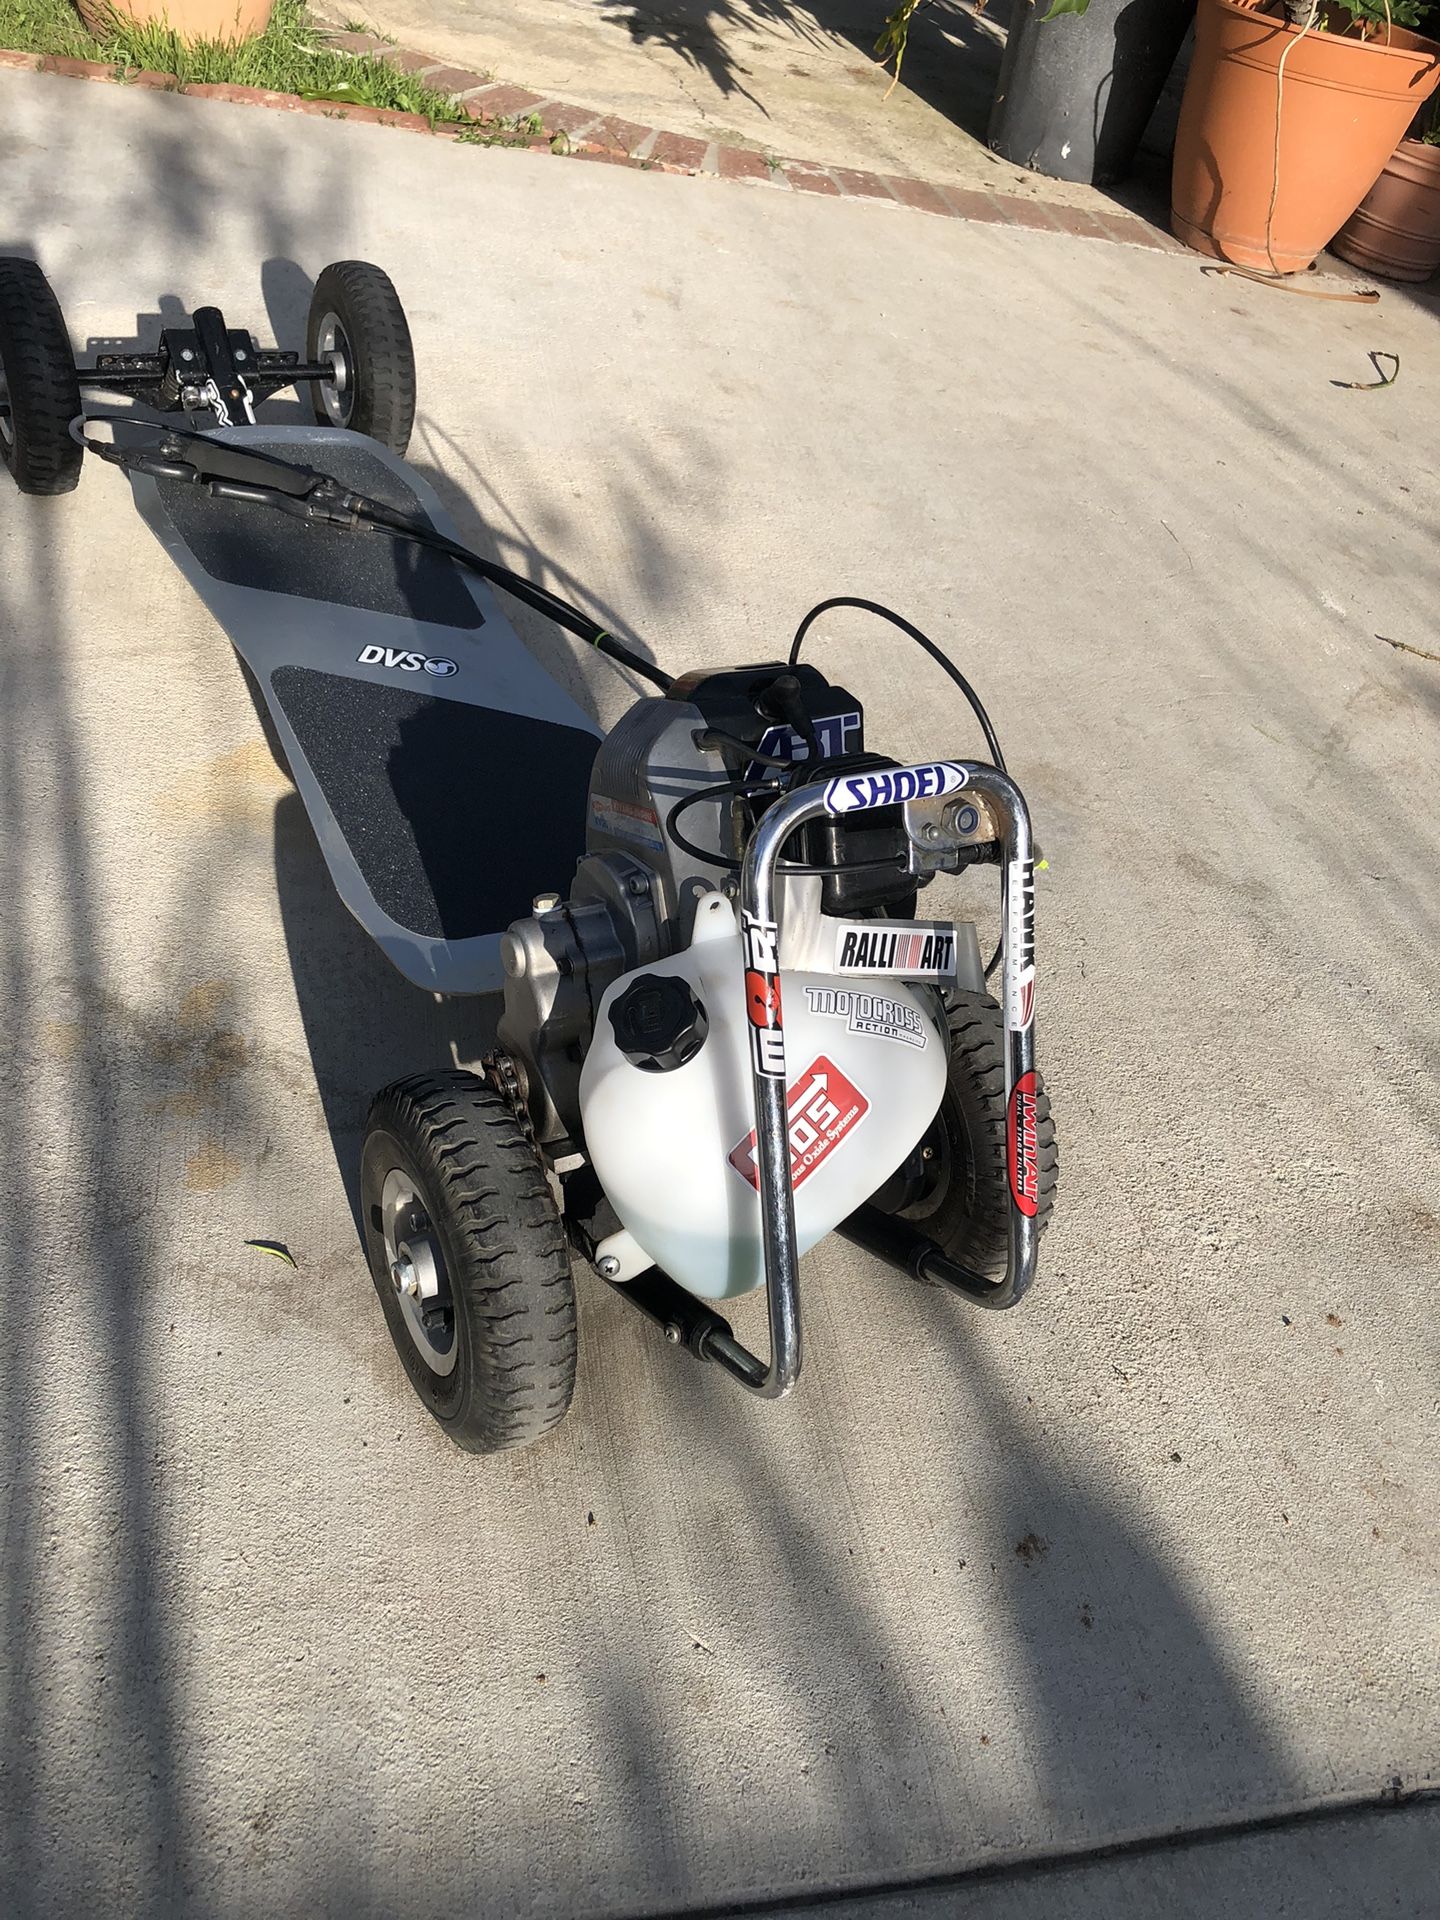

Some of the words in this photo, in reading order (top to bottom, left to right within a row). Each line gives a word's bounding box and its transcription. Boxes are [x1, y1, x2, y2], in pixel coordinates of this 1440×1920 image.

[358, 645, 426, 671] DVS
[845, 766, 946, 810] SHOEI
[805, 987, 923, 1035] MOTOCROSS
[856, 1021, 898, 1037] ACTION
[803, 1138, 831, 1166] Oxide
[826, 1104, 860, 1140] Systems
